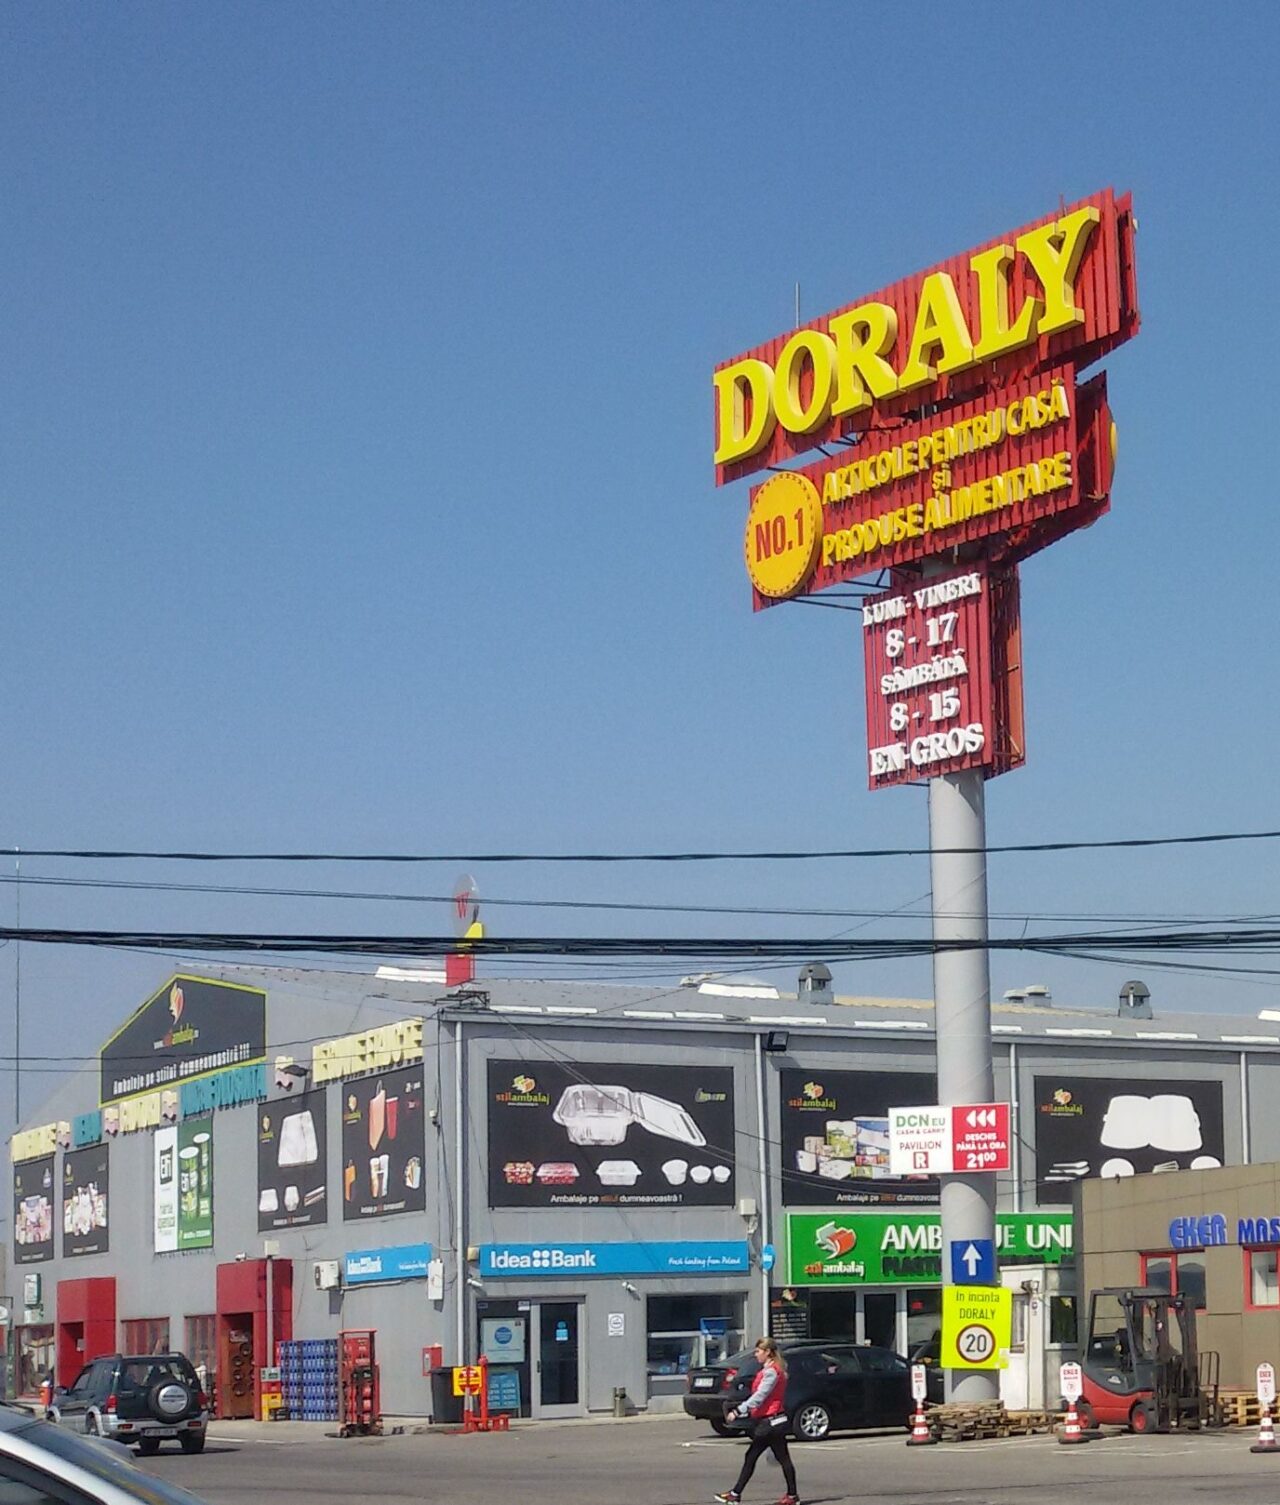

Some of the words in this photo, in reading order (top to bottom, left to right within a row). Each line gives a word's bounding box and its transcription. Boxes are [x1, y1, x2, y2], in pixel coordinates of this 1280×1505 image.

[713, 205, 1099, 464] DORALY
[823, 441, 919, 505] ARTICOLE
[918, 407, 1005, 467] PENTRU
[1006, 378, 1069, 436] CASĂ
[823, 503, 924, 566] PRODUSE
[923, 452, 1072, 531] ALIMENTARE
[755, 509, 804, 562] NO.1
[914, 572, 981, 609] VINERI
[886, 629, 904, 657] 8
[926, 612, 958, 646] 17
[891, 702, 908, 731] 8
[929, 687, 960, 721] 15
[870, 723, 985, 776] EN-GROS
[896, 1114, 930, 1127] DCN
[932, 1117, 945, 1127] EU
[899, 1141, 942, 1150] PAVILION
[965, 1132, 997, 1141] DESCHIS
[978, 1142, 988, 1150] LA
[989, 1141, 1006, 1149] ORA
[915, 1153, 927, 1168] R
[550, 1194, 587, 1204] Ambalaje
[589, 1195, 599, 1204] pe
[1169, 1213, 1227, 1248] EKER
[490, 1251, 531, 1268] Idea
[552, 1250, 596, 1267] Bank
[969, 1291, 999, 1303] incinta
[959, 1308, 996, 1320] DORALY
[966, 1333, 987, 1352] 20
